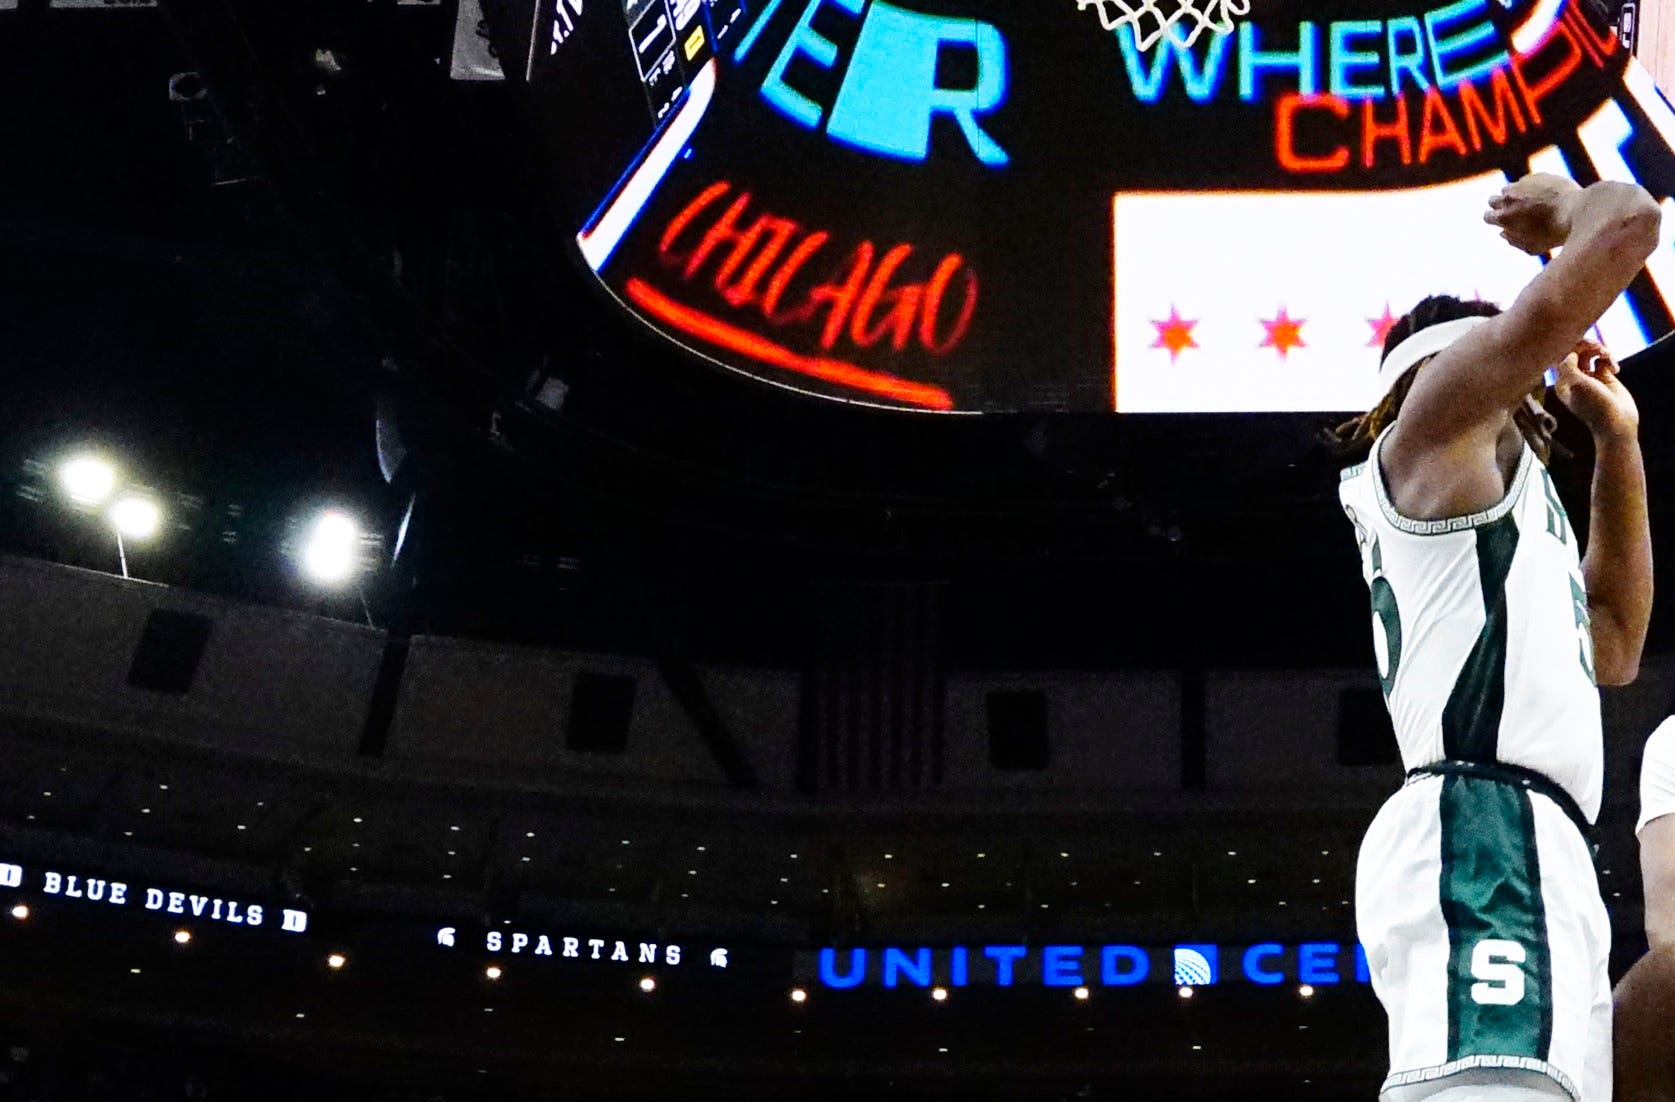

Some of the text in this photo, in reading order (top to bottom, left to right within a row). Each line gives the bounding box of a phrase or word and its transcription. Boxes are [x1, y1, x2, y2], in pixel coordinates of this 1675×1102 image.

[1115, 0, 1511, 102] WHERE
[1272, 0, 1618, 173] CHAMPI
[659, 180, 979, 356] CHICAGO
[43, 871, 127, 905] BLUE
[146, 887, 264, 928] DEVILS
[486, 930, 682, 967] SPARTANS
[819, 944, 1150, 988] UNITED
